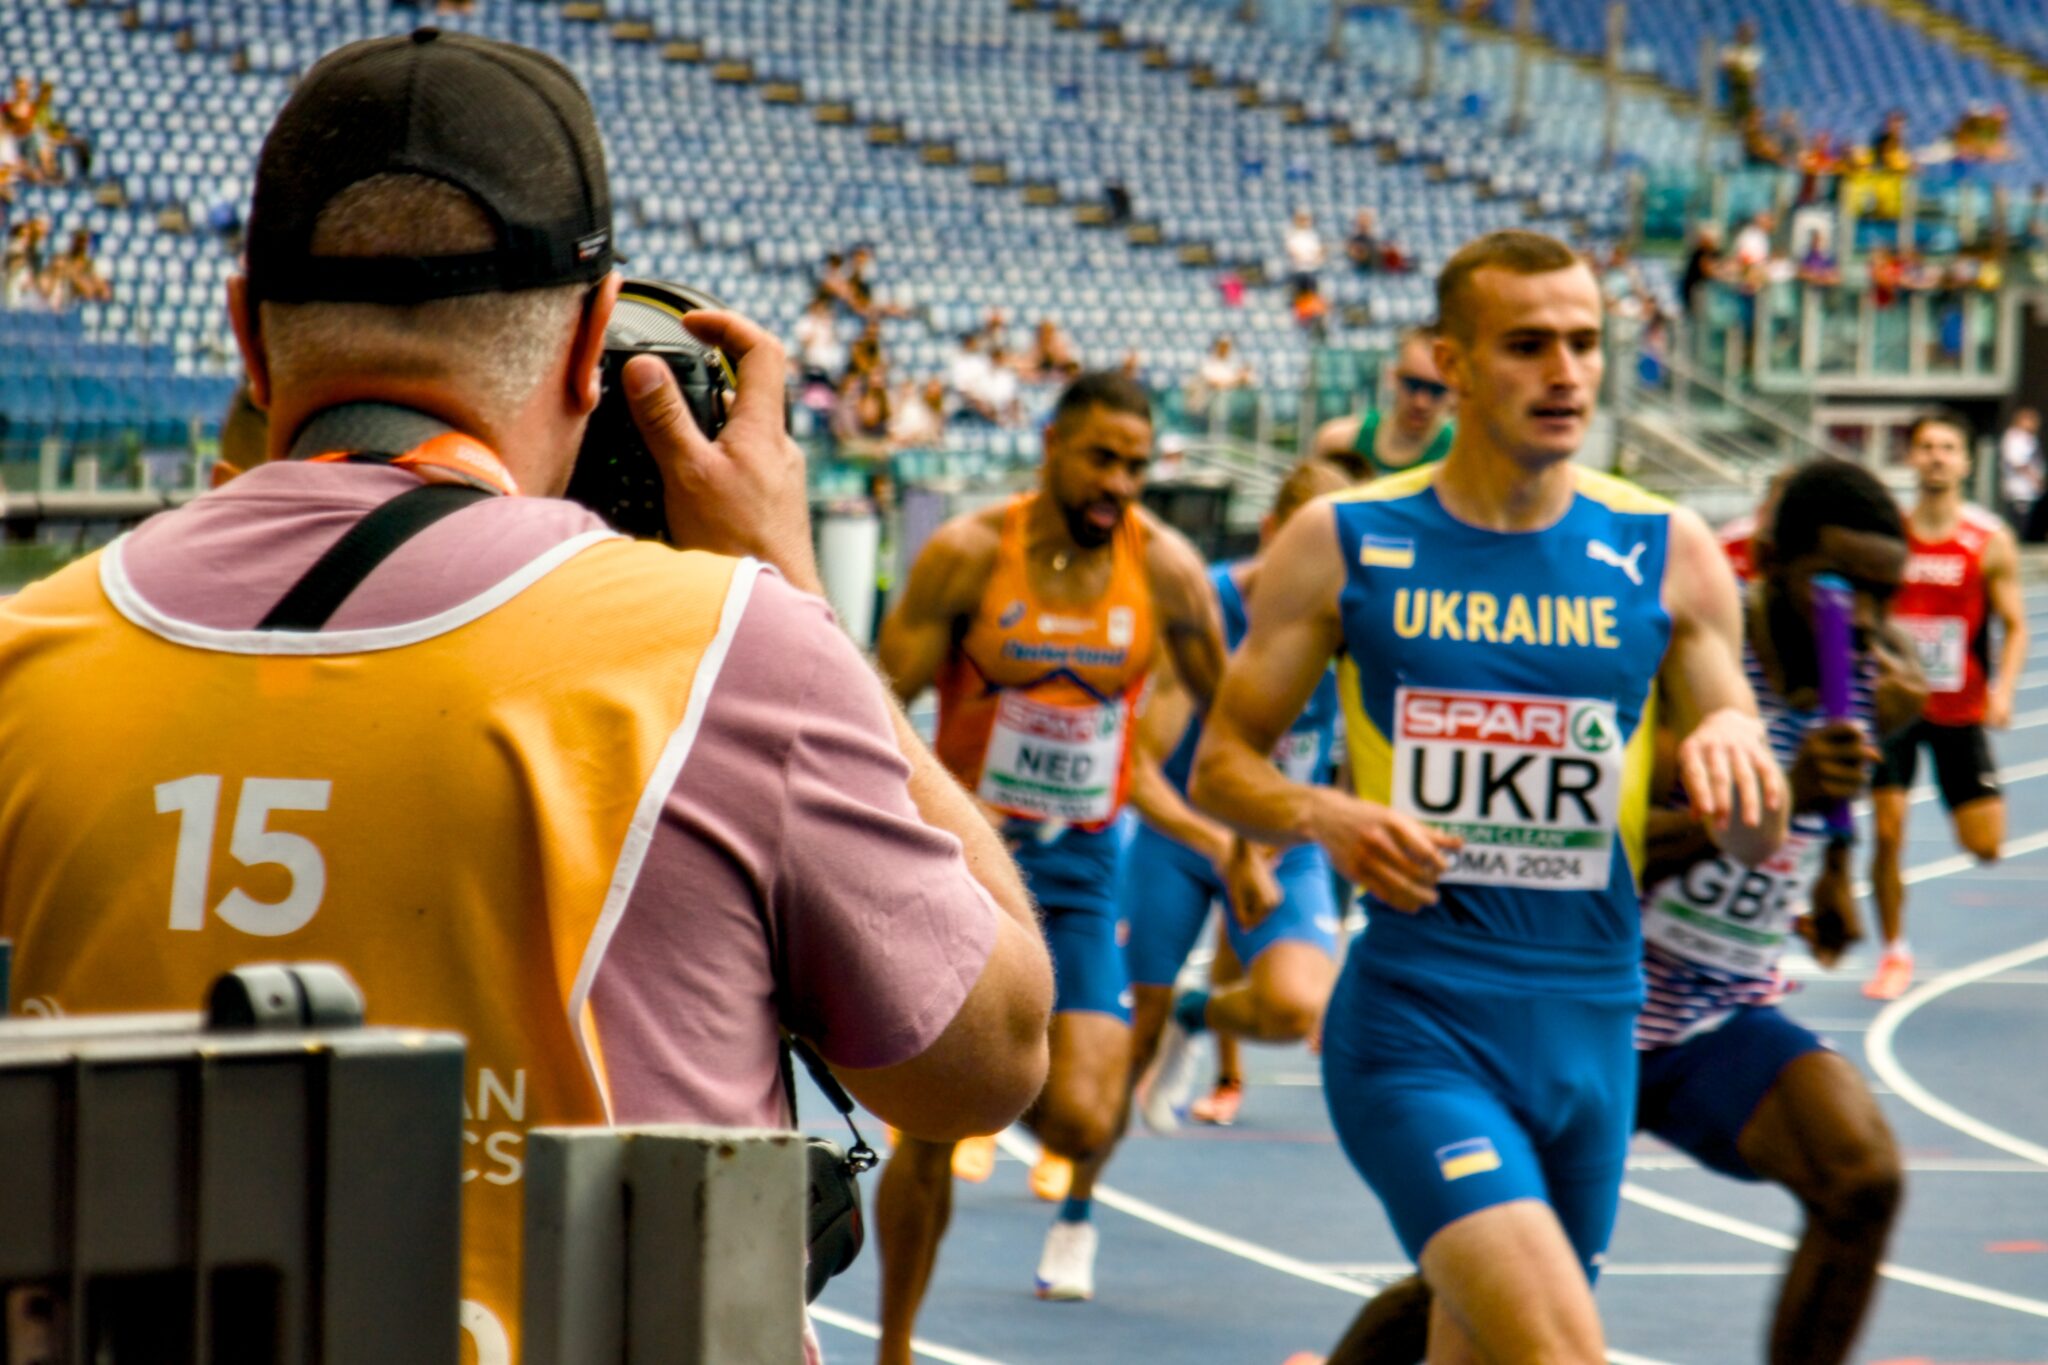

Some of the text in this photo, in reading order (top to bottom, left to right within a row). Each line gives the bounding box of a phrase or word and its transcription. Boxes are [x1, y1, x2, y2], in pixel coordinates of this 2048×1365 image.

[1393, 588, 1620, 649] UKRAINE
[1405, 699, 1564, 744] SPAR
[1016, 747, 1091, 783] NED
[1411, 748, 1603, 823] UKR
[154, 774, 332, 937] 15
[1516, 854, 1581, 880] 2024
